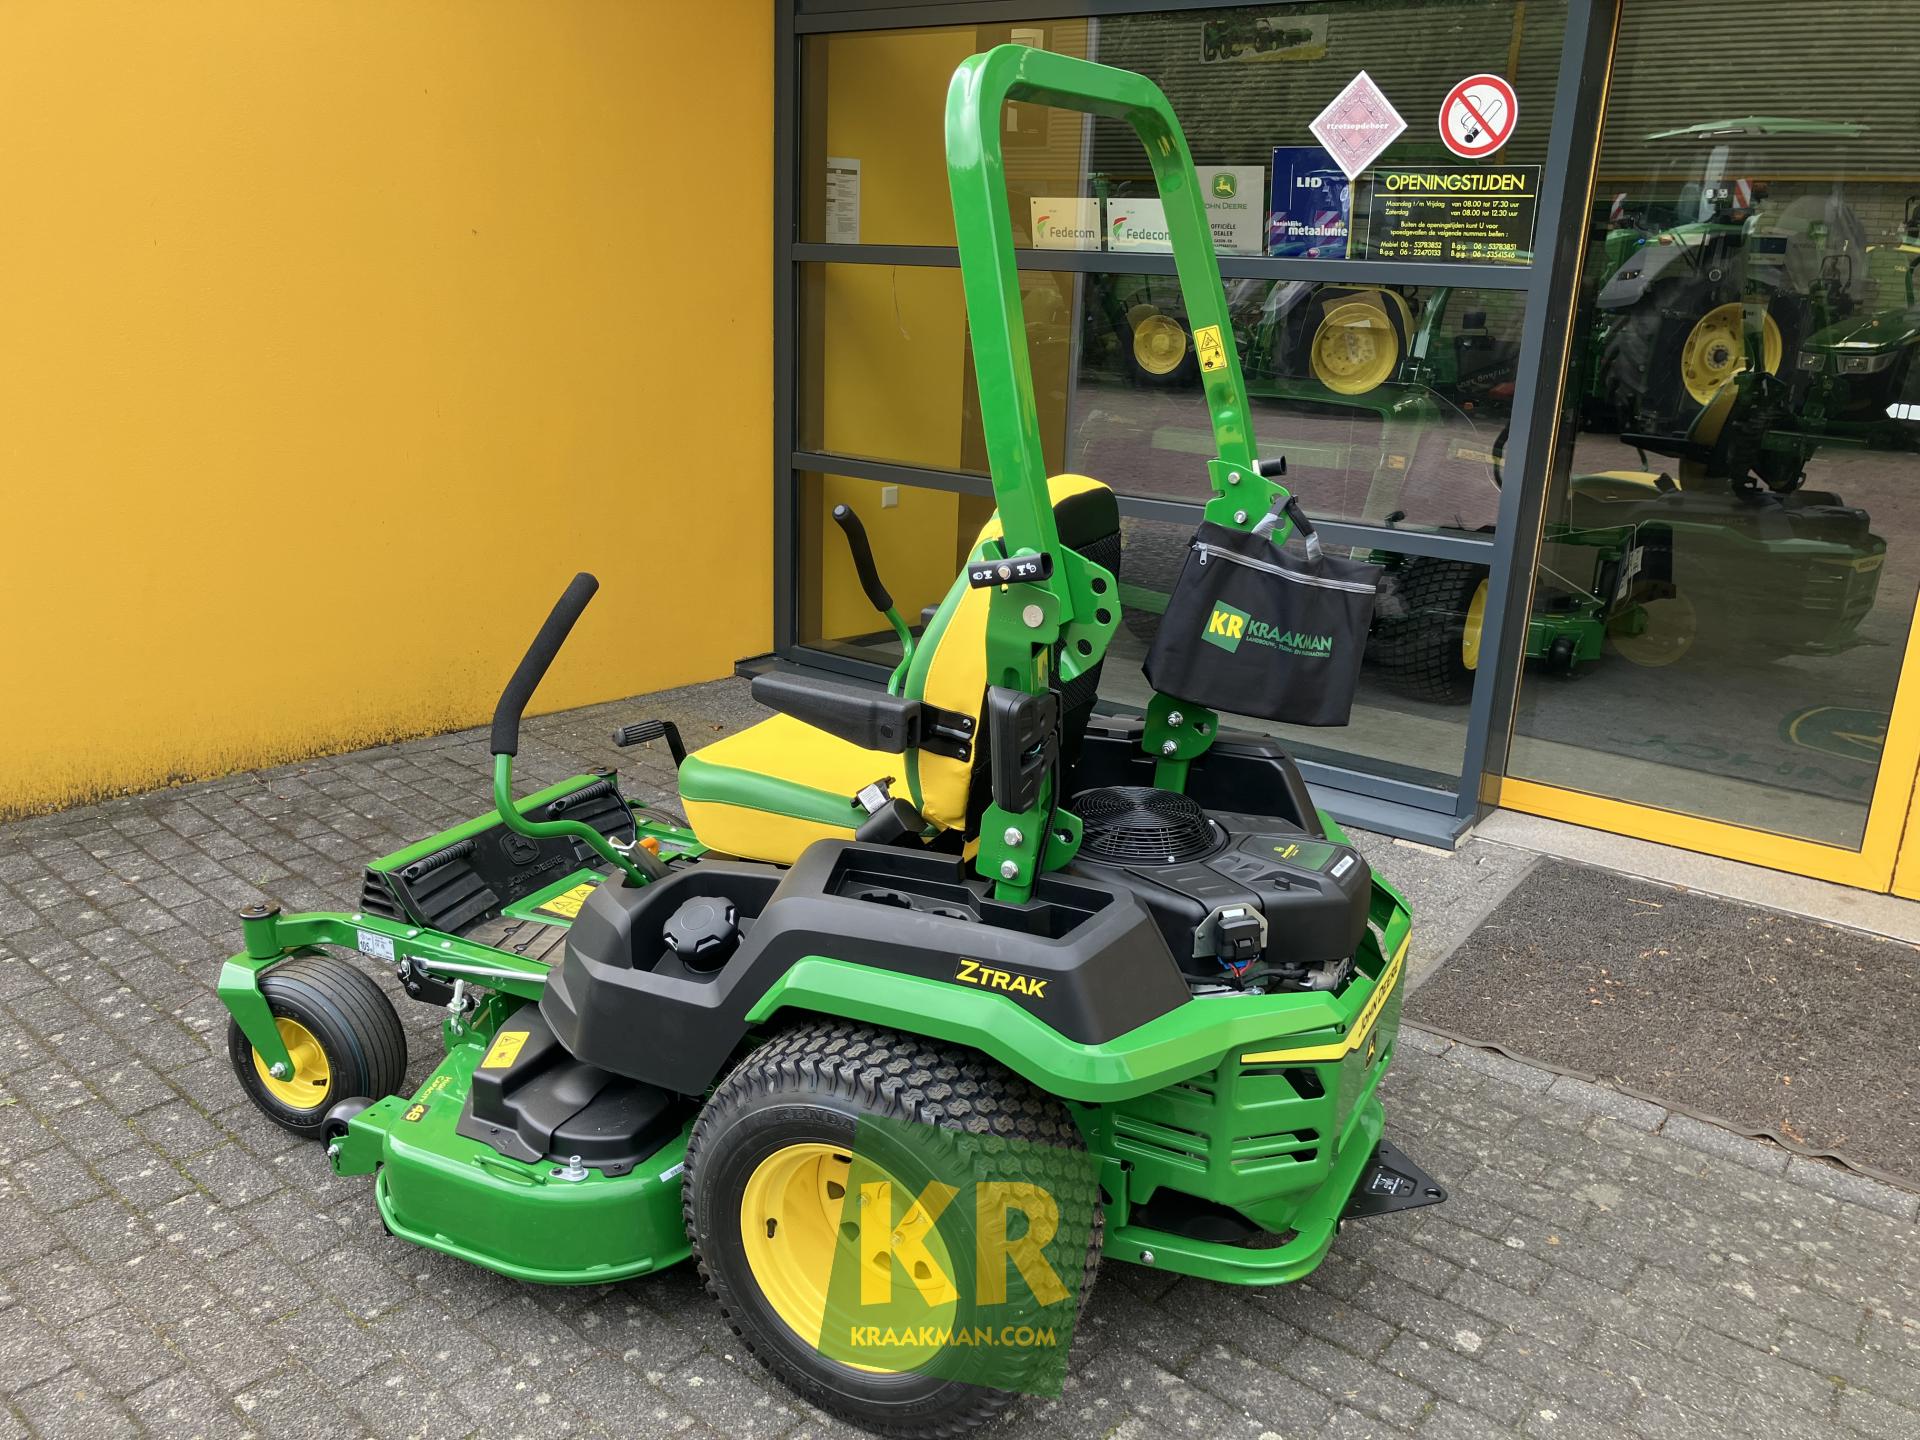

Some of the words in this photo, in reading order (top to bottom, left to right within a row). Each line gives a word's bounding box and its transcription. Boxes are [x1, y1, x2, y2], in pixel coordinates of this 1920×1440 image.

[1296, 176, 1322, 188] LID
[1386, 174, 1525, 191] OPENINGSTIJDEN
[1386, 200, 1411, 208] Maandag
[1426, 200, 1446, 208] Vrijdag
[1462, 200, 1482, 208] 08.00
[1492, 200, 1509, 208] 17.30
[1385, 208, 1409, 216] Zaterdag
[1462, 209, 1481, 217] 08.00
[1491, 209, 1508, 217] 12.30
[1050, 226, 1095, 239] Fedecom
[1399, 248, 1408, 256] 06
[1473, 242, 1482, 250] 06
[1472, 250, 1481, 258] 06
[1208, 610, 1244, 639] KR
[1247, 620, 1333, 651] KRAAKMAN
[534, 854, 565, 875] DEERE
[956, 959, 1048, 999] ZTRAK
[405, 1104, 425, 1121] 48
